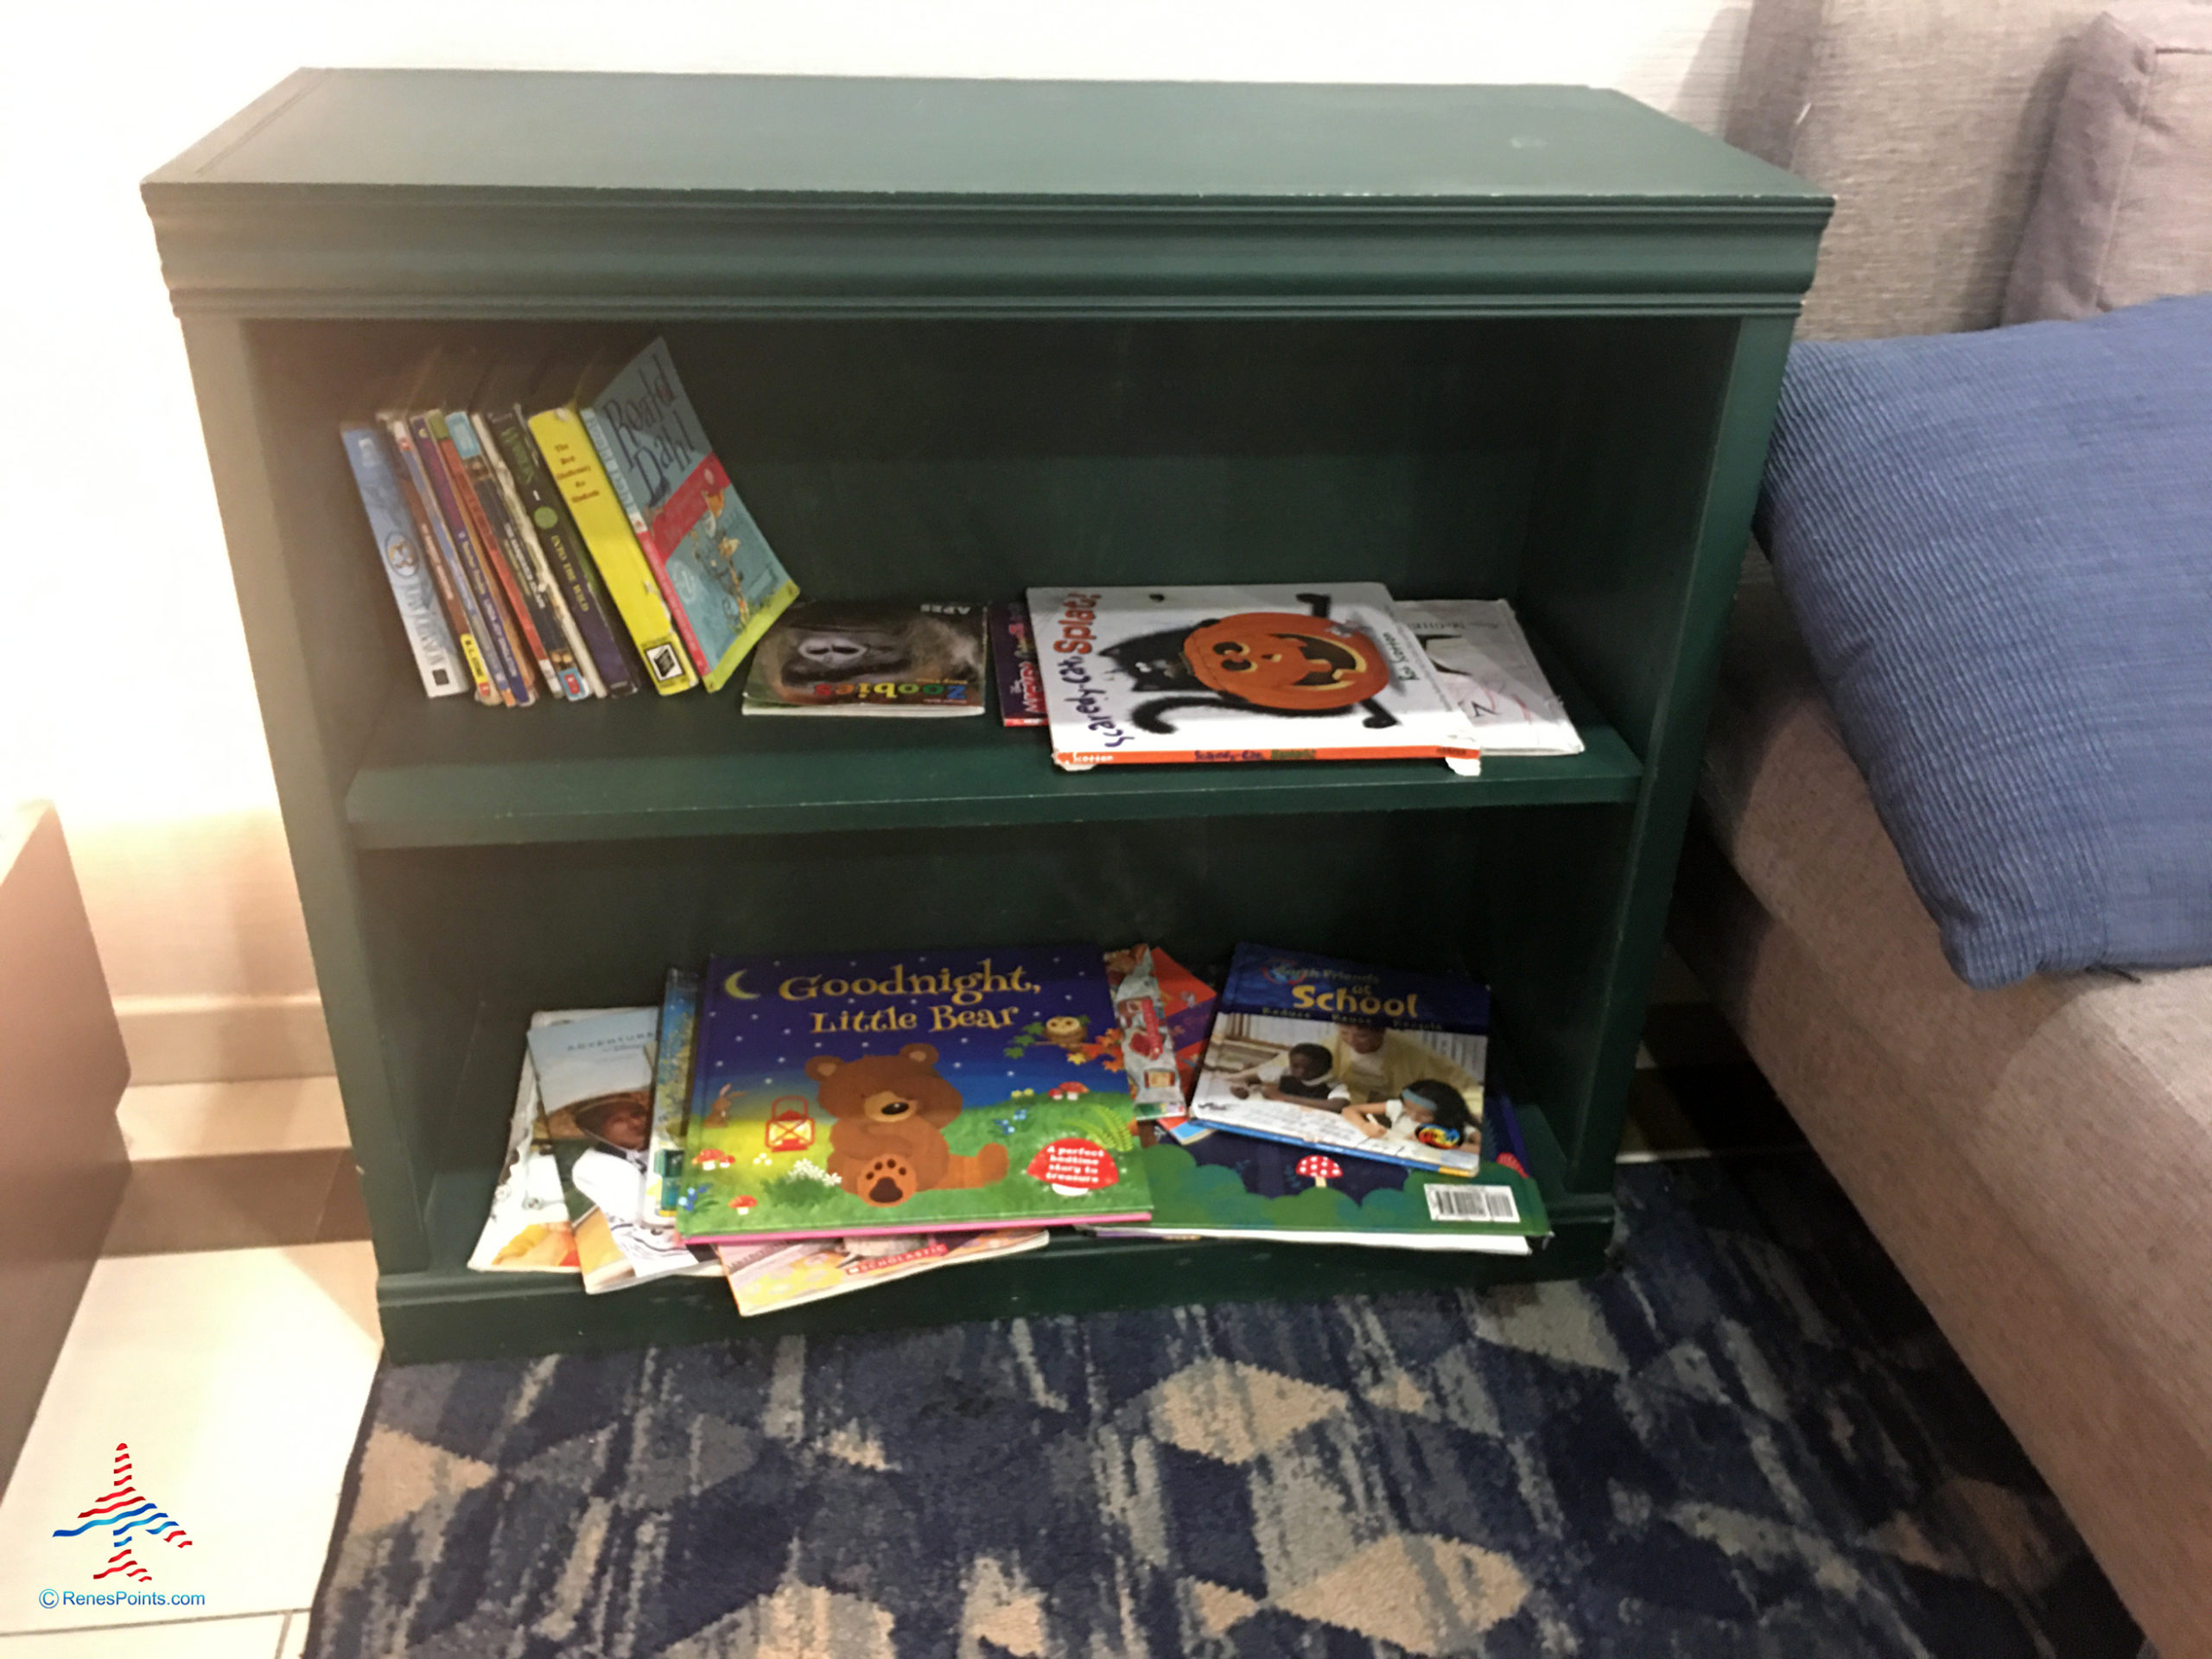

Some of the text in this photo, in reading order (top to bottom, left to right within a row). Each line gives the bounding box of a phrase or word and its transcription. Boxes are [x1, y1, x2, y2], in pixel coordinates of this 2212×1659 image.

[603, 353, 676, 473] Roald
[633, 410, 696, 508] Dahl
[550, 535, 589, 612] INTO THE WILD
[919, 604, 972, 615] APES
[1052, 591, 1102, 654] Splat!
[815, 682, 968, 700] Zoobies
[1072, 751, 1115, 765] Scotton
[779, 957, 1041, 1006] Goodnight,
[1291, 984, 1419, 1019] School
[810, 1004, 1020, 1034] Little Bear
[1046, 1145, 1105, 1158] A perfect
[1049, 1154, 1100, 1166] bedtime
[1046, 1171, 1100, 1184] treasure
[1048, 1163, 1099, 1174] story to
[861, 1244, 946, 1272] SCHOLASTIC
